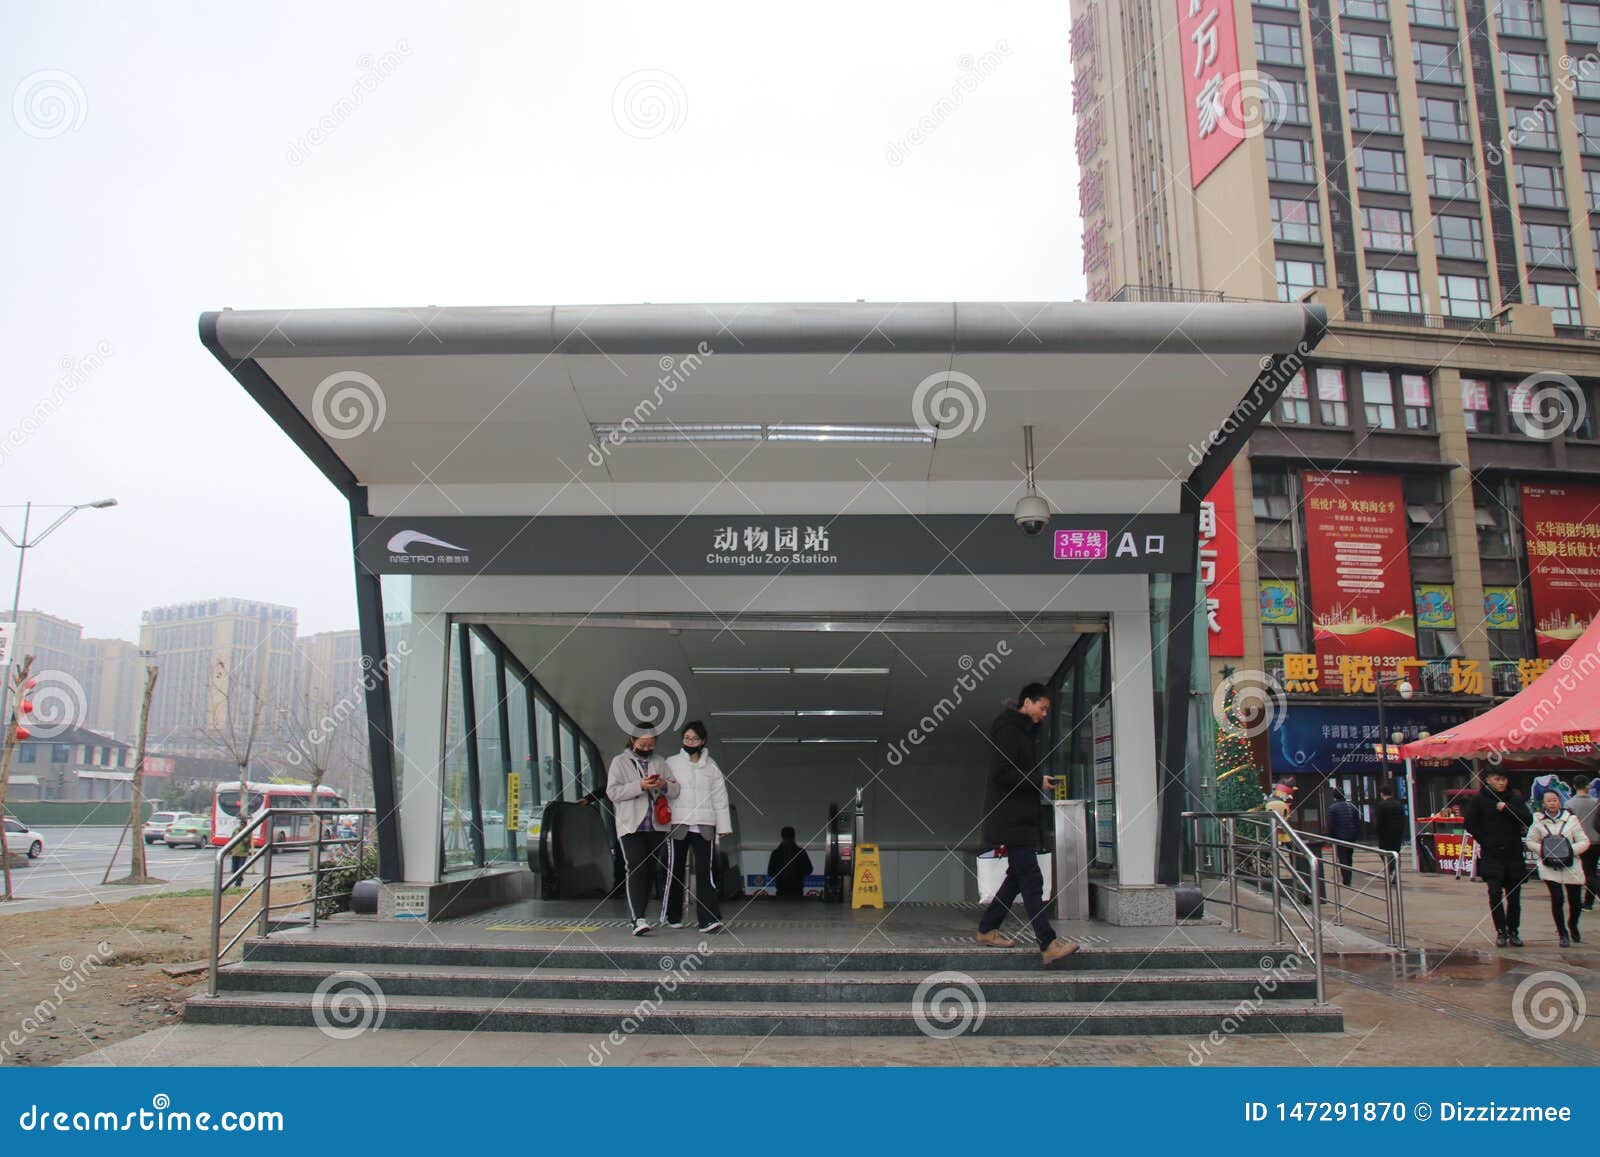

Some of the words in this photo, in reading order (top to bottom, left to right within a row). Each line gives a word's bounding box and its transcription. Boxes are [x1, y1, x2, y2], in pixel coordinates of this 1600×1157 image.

[713, 526, 829, 551] 动物园站
[1060, 532, 1103, 548] 3号线
[1115, 532, 1164, 557] A口
[706, 553, 762, 565] Chengdu
[766, 554, 789, 564] Zoo
[792, 553, 837, 564] Station
[1061, 548, 1090, 558] Line
[1094, 548, 1101, 558] 3
